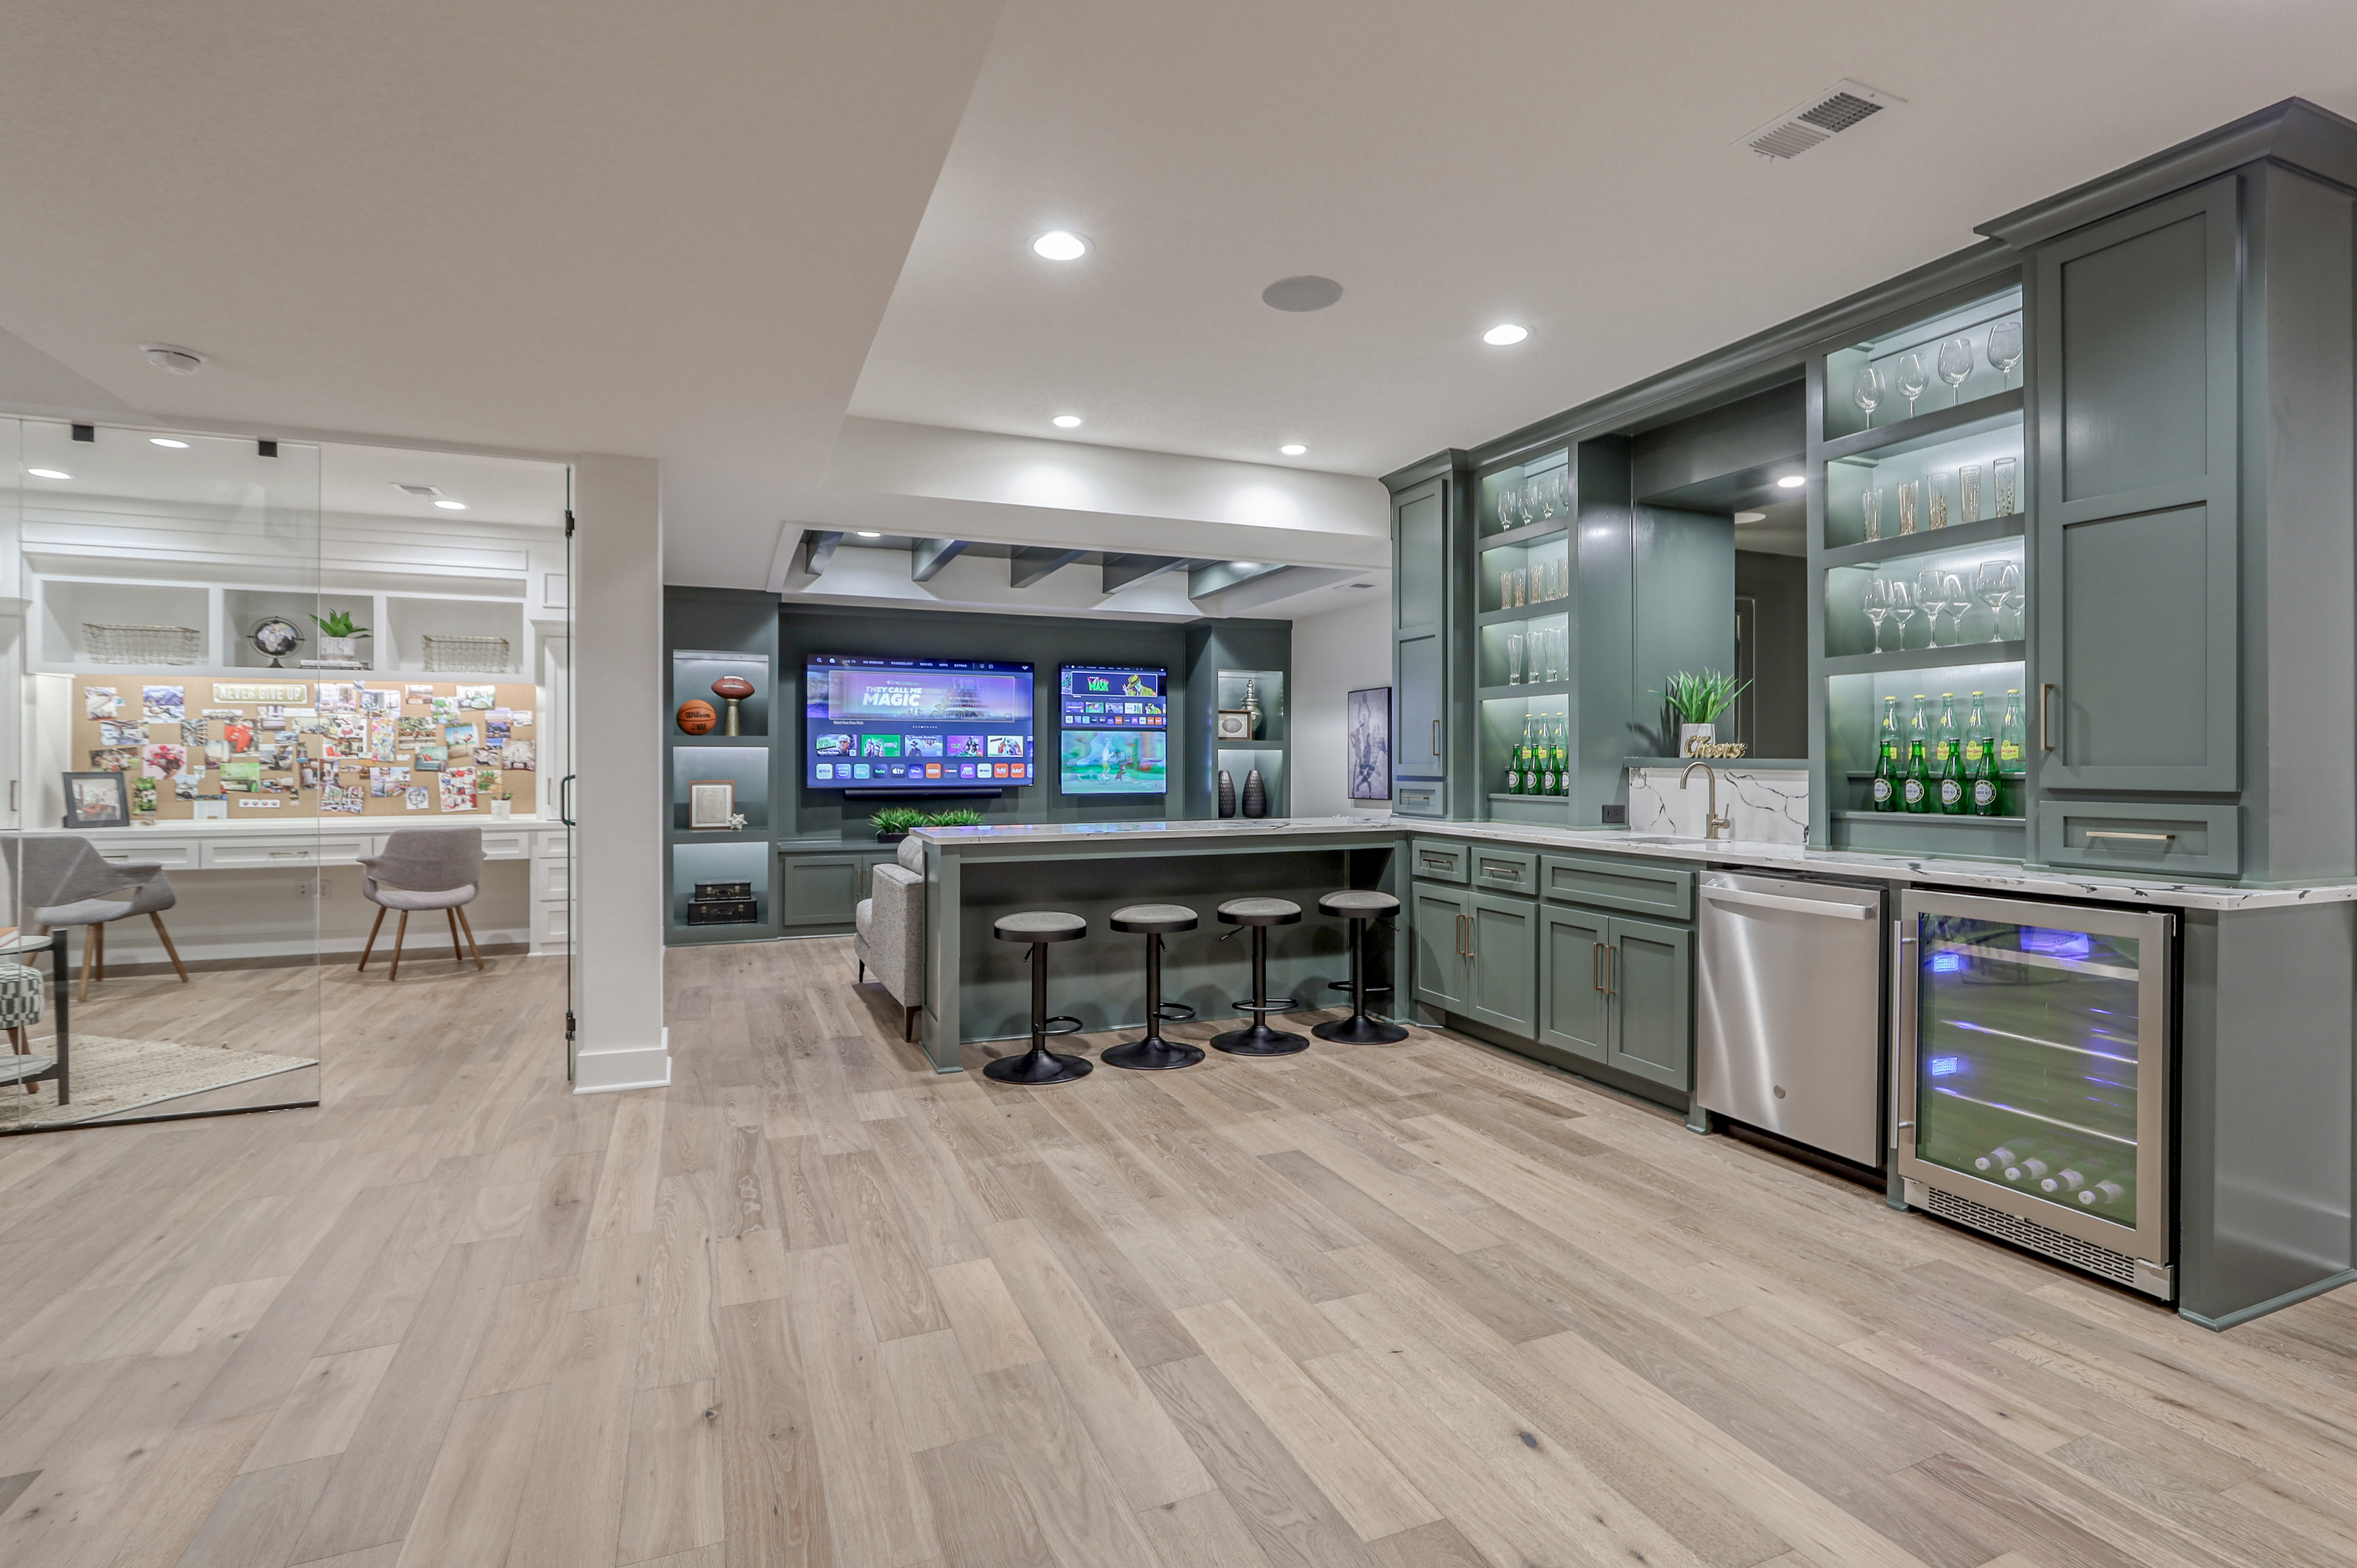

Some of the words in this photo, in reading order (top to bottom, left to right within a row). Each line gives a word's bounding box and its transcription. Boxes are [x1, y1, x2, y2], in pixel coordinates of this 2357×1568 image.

[1087, 676, 1110, 692] MASK
[220, 687, 256, 700] NEVER
[259, 687, 284, 700] GIVE
[287, 687, 301, 700] UP
[862, 692, 921, 706] MAGIC
[1684, 735, 1748, 759] Cheers
